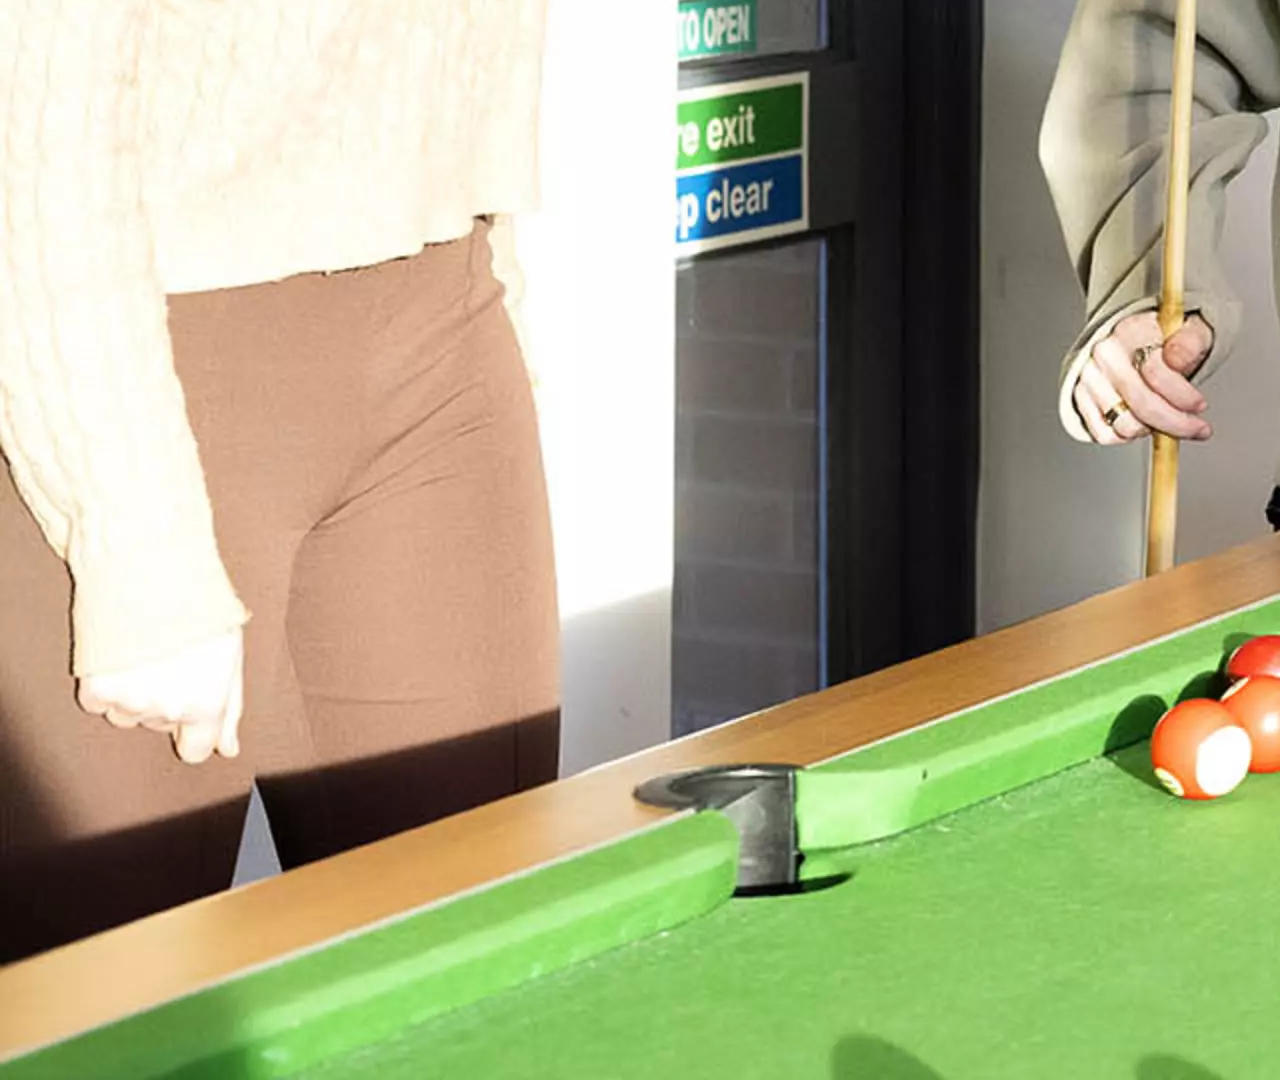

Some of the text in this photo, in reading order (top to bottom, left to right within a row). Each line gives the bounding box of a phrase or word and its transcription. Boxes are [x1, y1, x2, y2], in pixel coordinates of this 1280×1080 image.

[703, 4, 750, 48] OPEN
[707, 105, 755, 151] exit
[706, 179, 774, 223] clear
